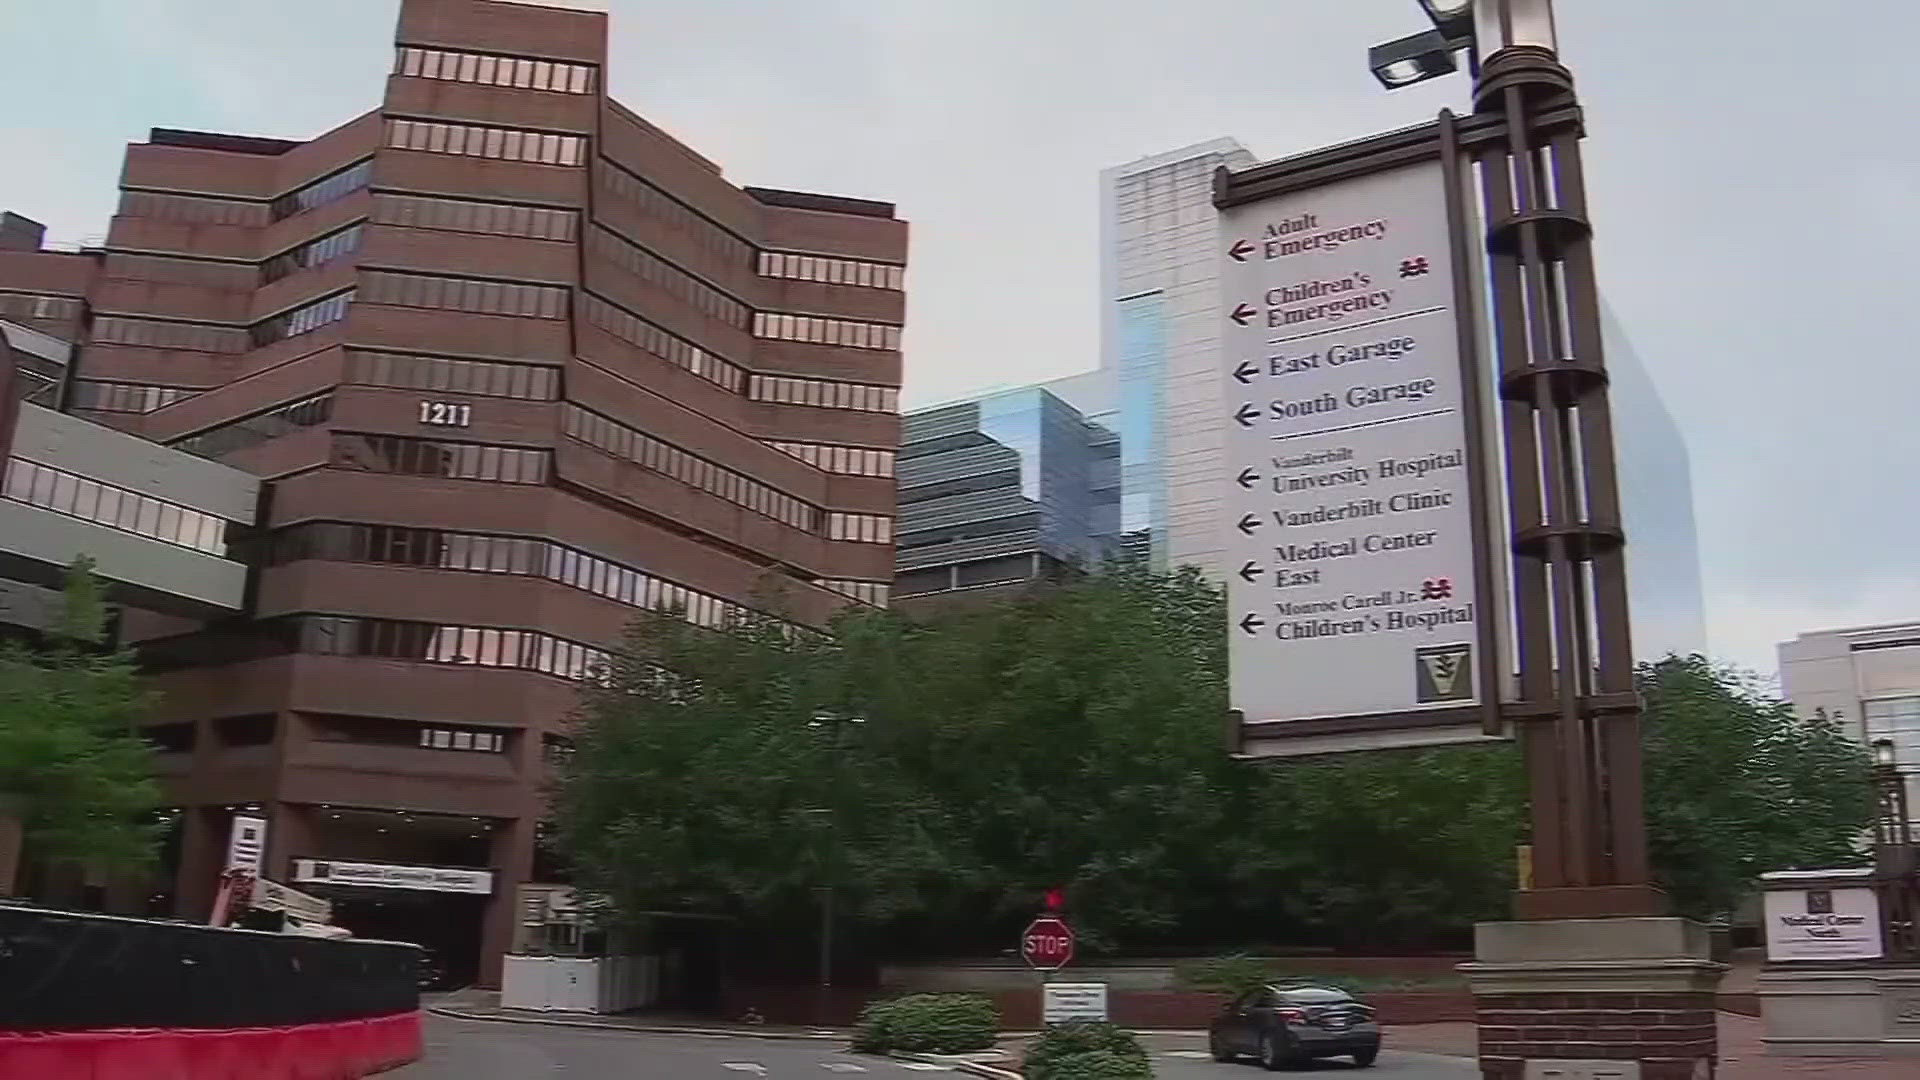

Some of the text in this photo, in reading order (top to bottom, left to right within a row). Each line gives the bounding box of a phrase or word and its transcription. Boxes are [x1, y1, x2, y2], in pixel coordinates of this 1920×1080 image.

[1264, 219, 1388, 260] Emergency
[1265, 213, 1318, 239] Adult
[1265, 271, 1371, 307] Children's
[1267, 290, 1393, 328] Emergency
[1270, 336, 1416, 377] East Garage
[420, 401, 470, 427] 1211
[1270, 376, 1436, 421] South Garage
[1272, 449, 1463, 494] University Hospital
[1273, 490, 1453, 527] Vanderbilt Clinic
[1274, 530, 1438, 563] Medical Center
[1275, 567, 1321, 588] East
[1276, 603, 1474, 641] Children's Hospital
[1024, 935, 1069, 954] STOP
